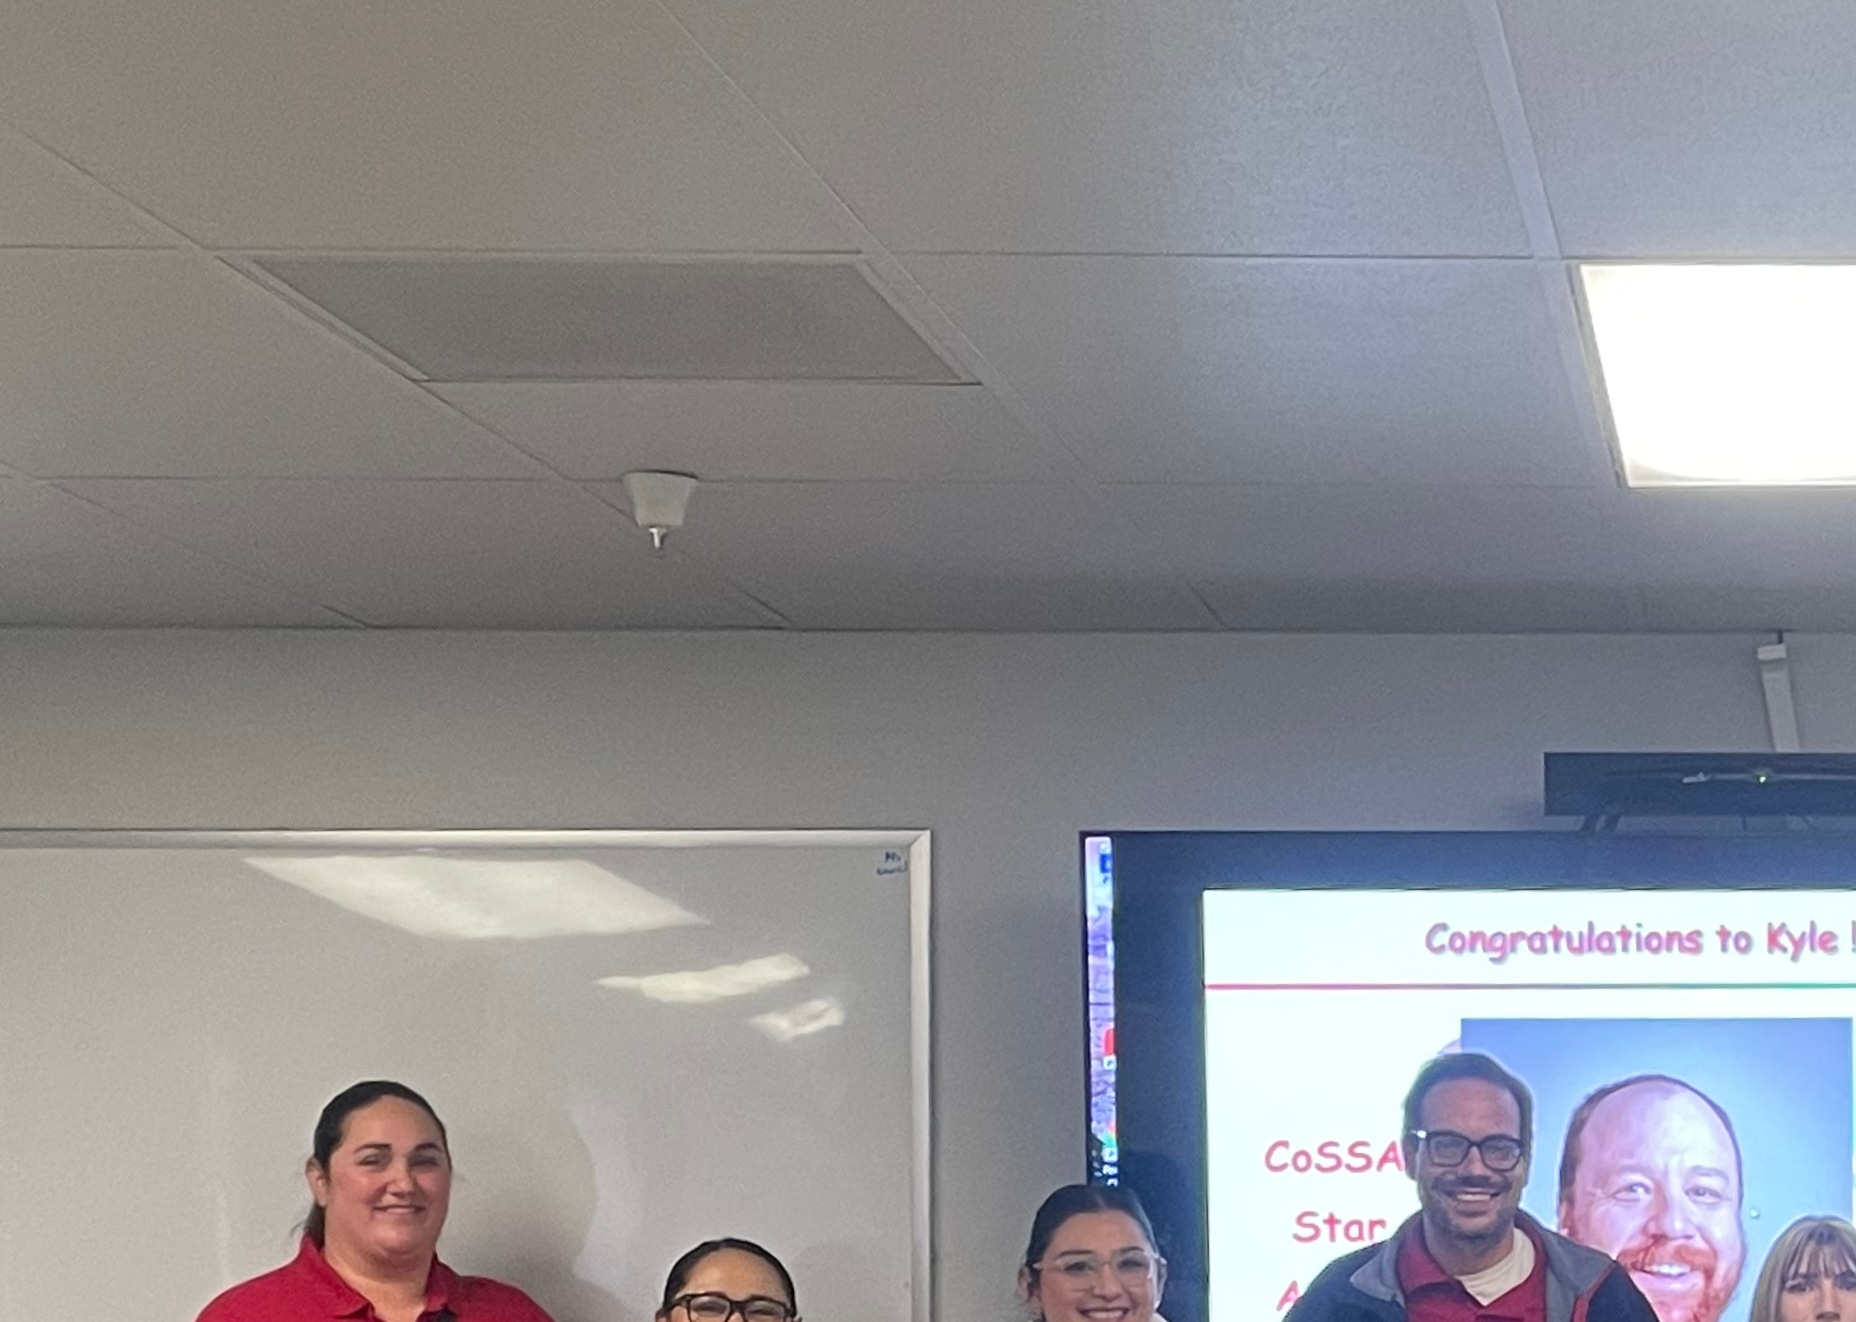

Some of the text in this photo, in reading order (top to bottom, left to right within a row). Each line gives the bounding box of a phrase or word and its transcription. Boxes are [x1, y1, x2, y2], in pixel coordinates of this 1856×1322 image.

[1425, 920, 1704, 964] Congratulations
[1715, 924, 1754, 955] to
[1766, 920, 1839, 963] Kyle
[1264, 1139, 1406, 1173] CoSSA
[1292, 1210, 1387, 1243] Star
